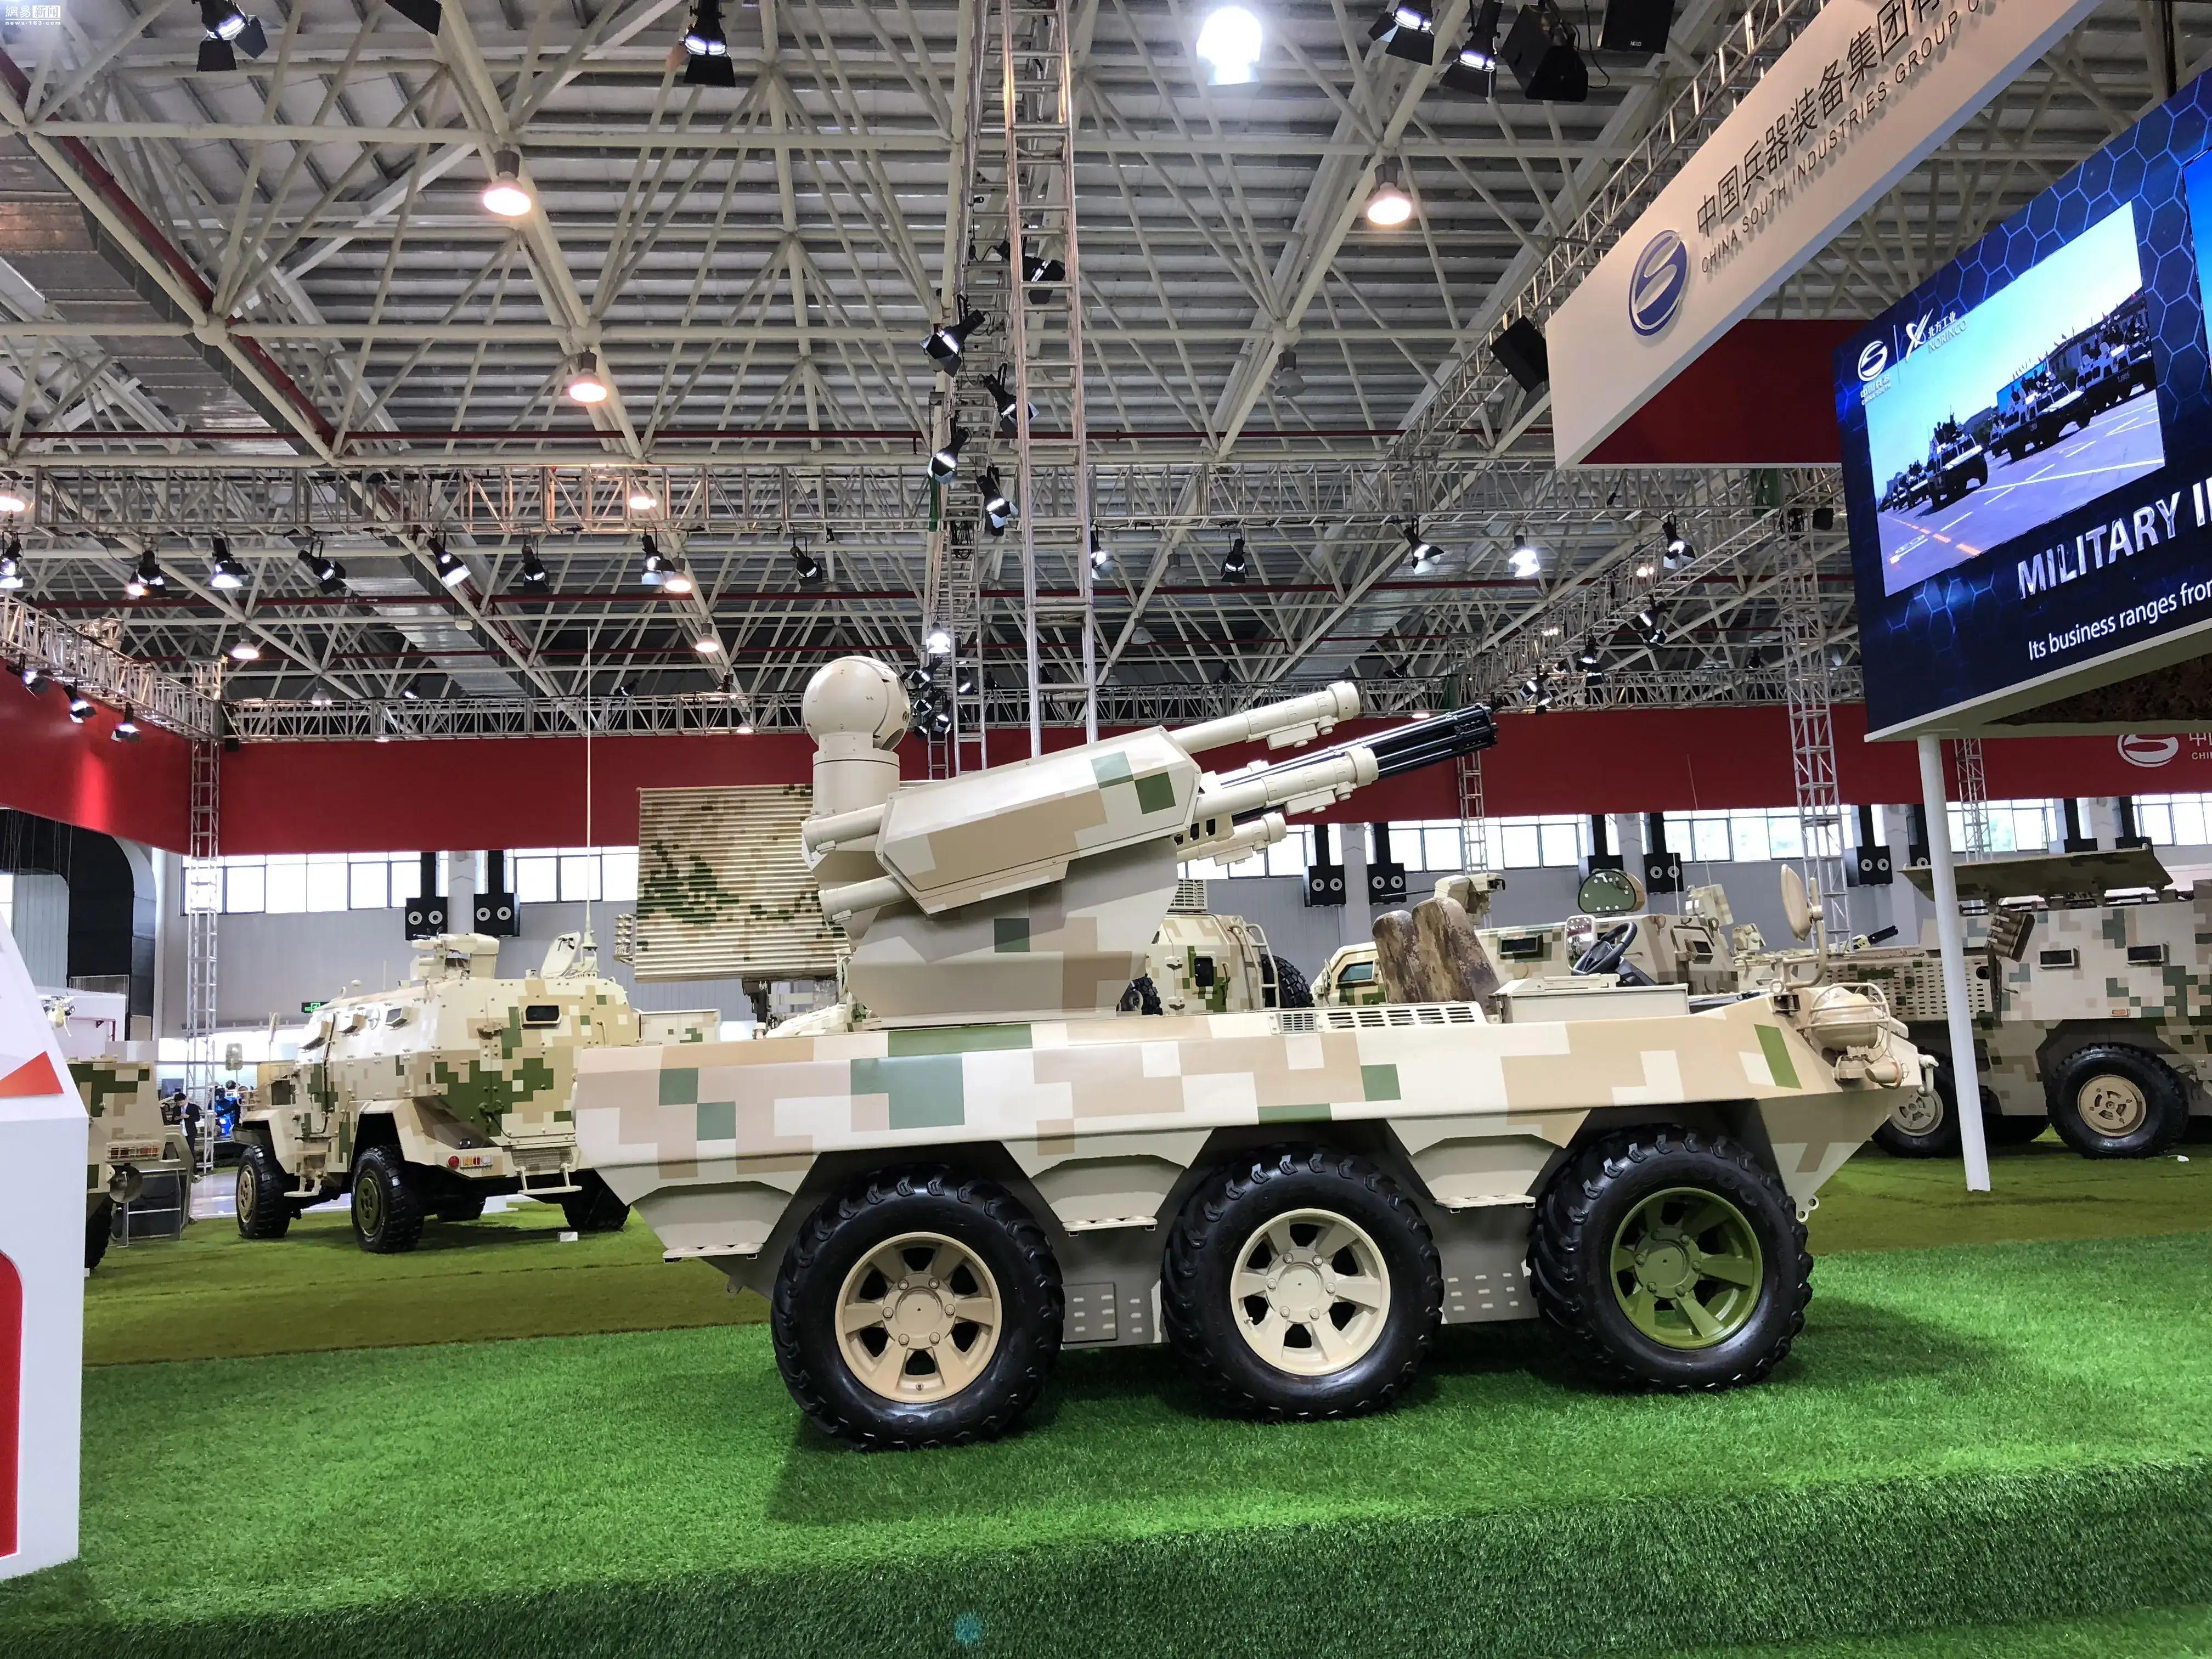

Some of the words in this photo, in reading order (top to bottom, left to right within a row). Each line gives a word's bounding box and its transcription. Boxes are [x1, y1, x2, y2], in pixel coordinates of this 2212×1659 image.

[1702, 229, 1738, 273] CHINA
[1742, 179, 1786, 233] SOUTH
[1792, 81, 1887, 185] INDUSTRIES
[1895, 10, 1958, 83] GROUP
[1928, 320, 1967, 354] NORINCO
[2017, 491, 2181, 600] MILITARY
[2028, 640, 2047, 662] Its
[2049, 615, 2116, 654] business
[2119, 592, 2177, 624] ranges
[2191, 752, 2212, 760] CHI
